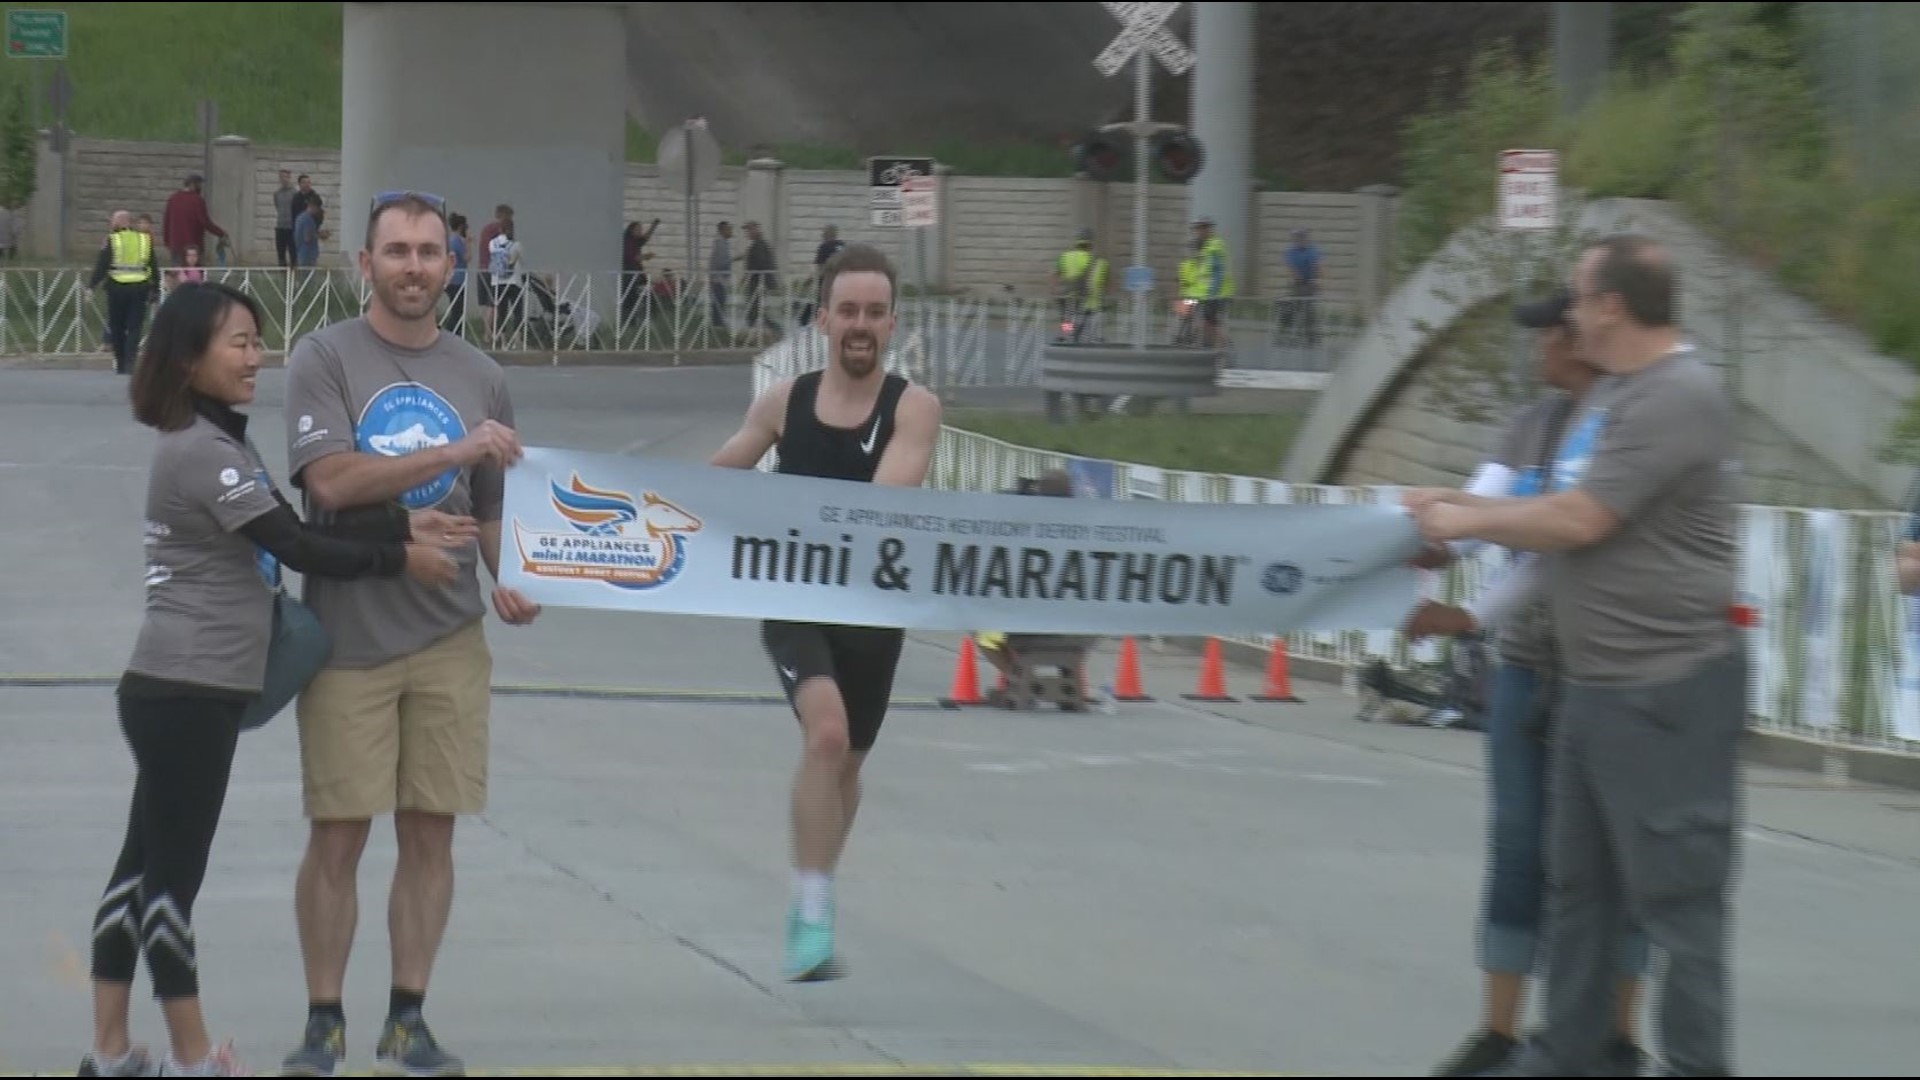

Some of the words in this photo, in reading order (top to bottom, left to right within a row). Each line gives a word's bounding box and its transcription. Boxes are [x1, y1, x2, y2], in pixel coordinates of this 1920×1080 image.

[818, 505, 842, 523] GE
[845, 508, 945, 533] APPLIANCES
[540, 537, 557, 547] GE
[562, 538, 650, 553] APPLIANCES
[532, 549, 563, 561] mini
[574, 551, 657, 568] MARATHON
[732, 528, 853, 587] mini
[873, 537, 912, 592] &
[931, 541, 1239, 607] MARATHON
